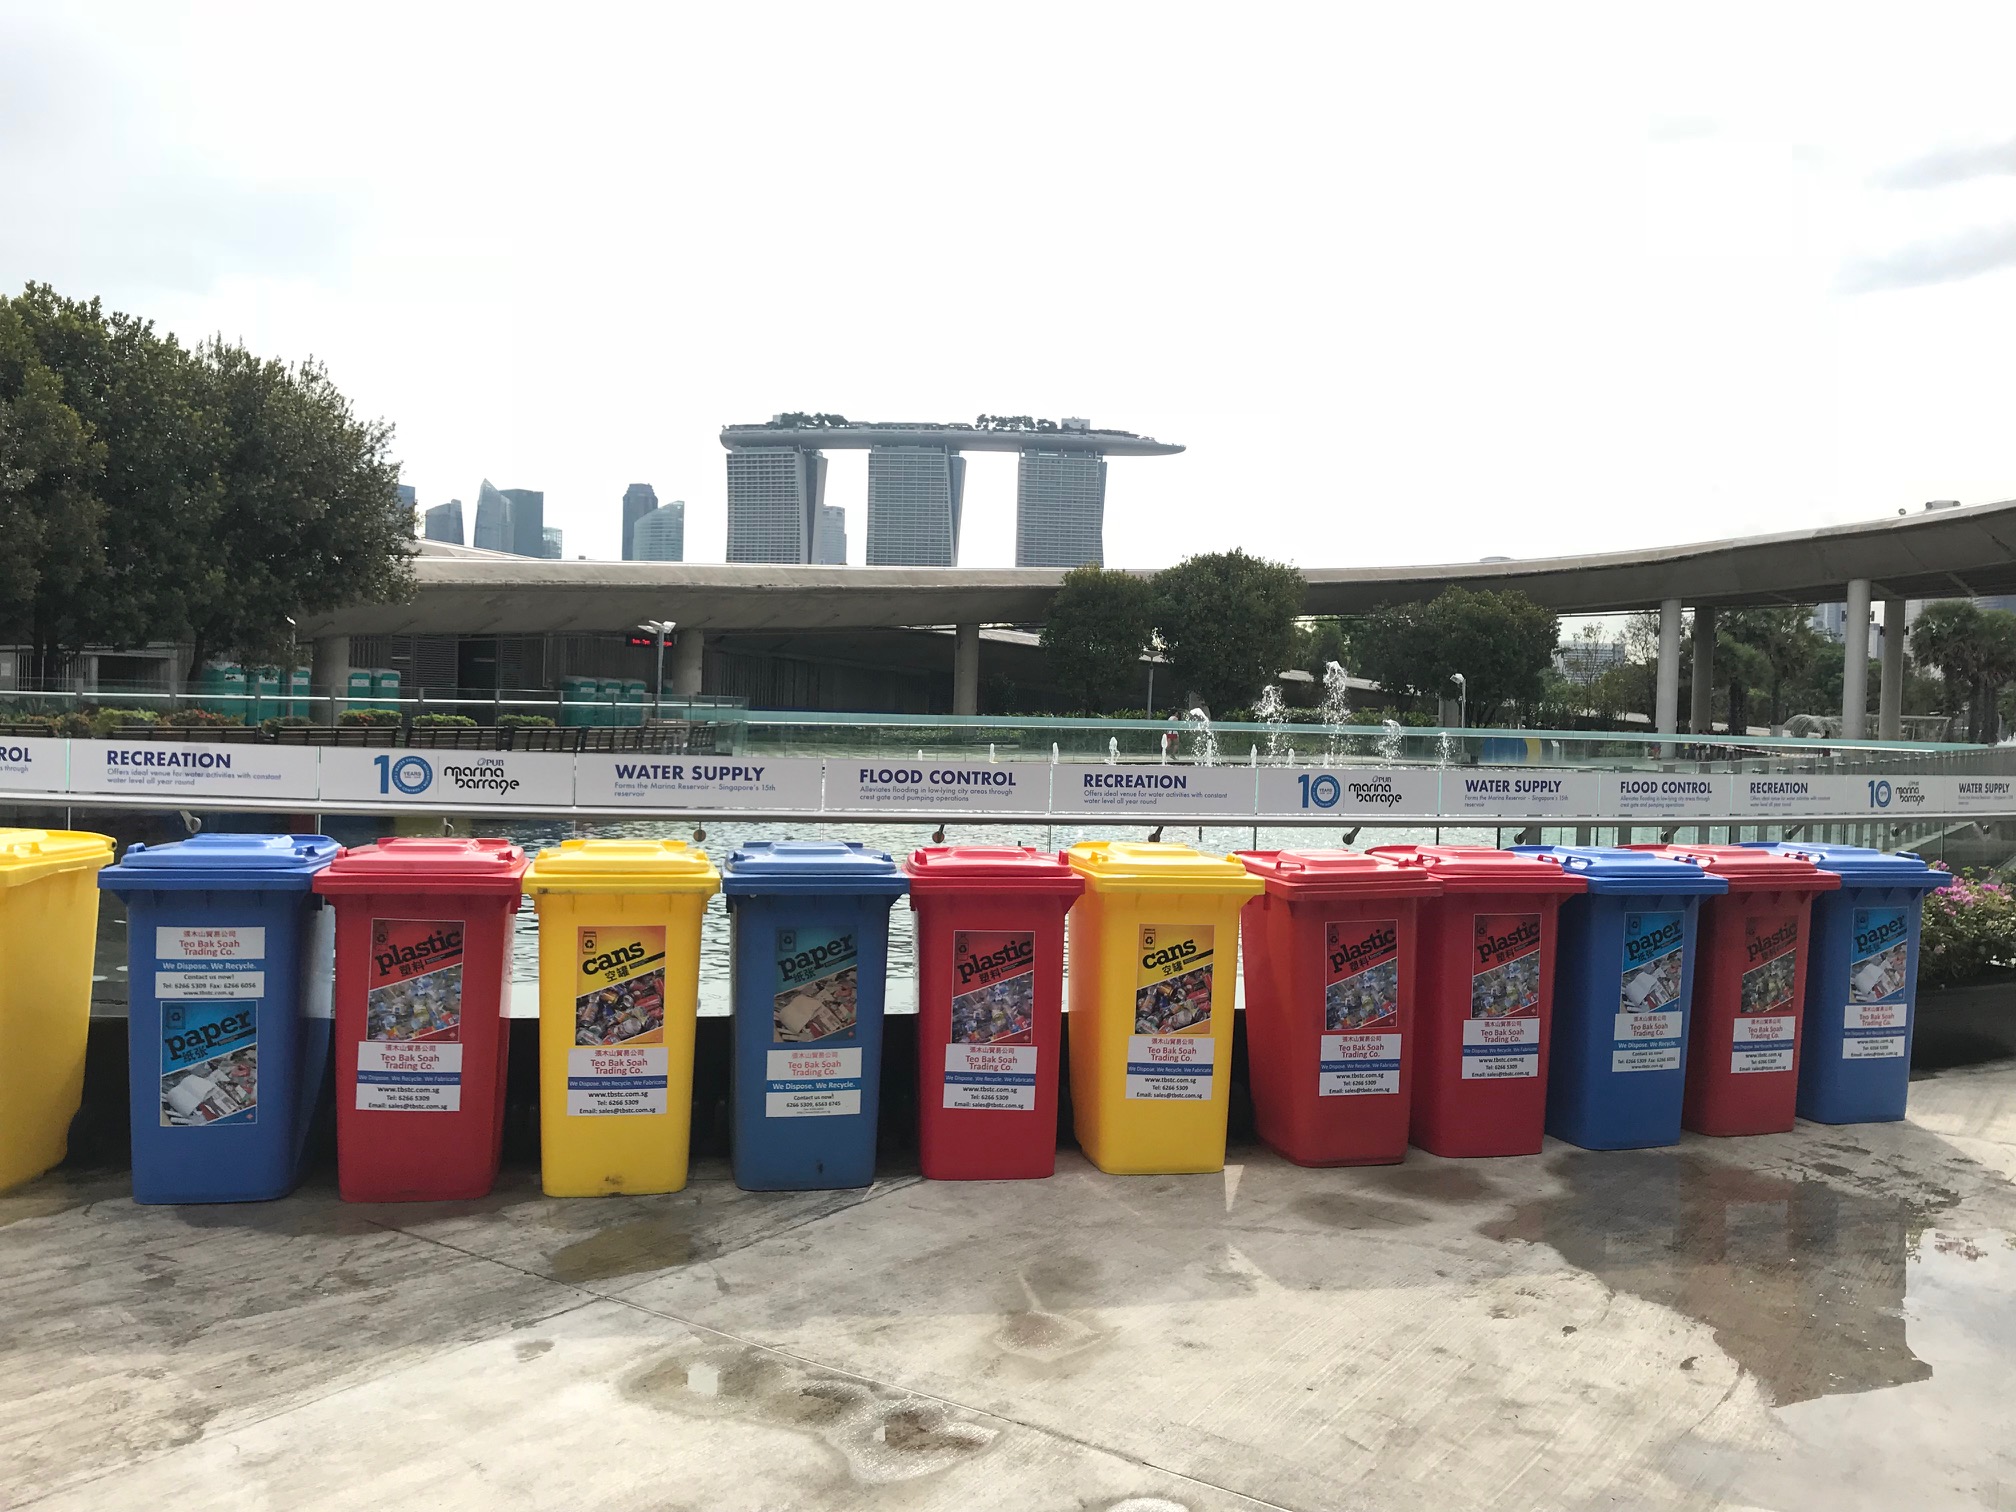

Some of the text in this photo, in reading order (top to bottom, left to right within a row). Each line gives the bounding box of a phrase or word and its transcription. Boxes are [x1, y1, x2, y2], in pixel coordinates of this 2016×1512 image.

[107, 750, 231, 769] RECREATION
[4, 765, 29, 773] through
[107, 768, 129, 776] Offers
[131, 769, 149, 777] ideal
[172, 770, 183, 778] for
[205, 771, 235, 780] activities
[236, 772, 251, 780] with
[374, 755, 433, 795] 10
[444, 766, 504, 777] marina
[615, 764, 765, 781] WATER SUPPLY
[128, 777, 145, 786] level
[146, 778, 156, 786] all
[156, 780, 173, 788] year
[174, 778, 195, 787] round
[860, 769, 1016, 786] FLOOD CONTROL
[1084, 774, 1187, 788] RECREATION
[455, 773, 520, 795] barrage
[1348, 783, 1391, 792] marina
[1465, 780, 1562, 793] WATER SUPPLY
[1620, 781, 1712, 794] FLOOD CONTROL
[1750, 782, 1808, 794] RECREATION
[1958, 783, 2010, 793] WATER SUPPLY
[892, 786, 919, 795] flooding
[928, 787, 956, 796] low-lying
[957, 788, 969, 796] city
[988, 788, 1013, 797] through
[1298, 774, 1340, 808] 10
[1868, 780, 1892, 808] 10
[1357, 791, 1402, 807] barrage
[1854, 915, 1905, 953] paper
[179, 940, 240, 948] Teo Bak Soah
[1477, 922, 1540, 963] plastic
[1625, 920, 1681, 961] paper
[1747, 922, 1797, 962] plastic
[184, 948, 235, 957] Trading Co.
[375, 930, 462, 976] plastic
[1142, 939, 1197, 969] cans
[1330, 929, 1396, 973] plastic
[582, 942, 645, 975] cans
[778, 934, 853, 981] paper
[957, 940, 1033, 984] plastic
[177, 962, 209, 971] Dispose.
[210, 962, 224, 970] We
[225, 962, 257, 971] Recycle.
[165, 1009, 251, 1060] paper
[1178, 1047, 1197, 1055] Soah
[380, 1054, 440, 1062] Teo Bak Soah
[590, 1058, 648, 1067] Teo Bak Soah
[821, 1060, 841, 1068] Soah
[966, 1055, 979, 1063] Teo
[998, 1056, 1018, 1064] Soah
[1151, 1054, 1179, 1062] Trading
[385, 1062, 435, 1071] Trading Co.
[595, 1066, 643, 1075] Trading Co.
[969, 1063, 998, 1071] Trading
[792, 1069, 822, 1077] Trading
[785, 1083, 814, 1091] Dispose.
[829, 1081, 856, 1089] Recycle.
